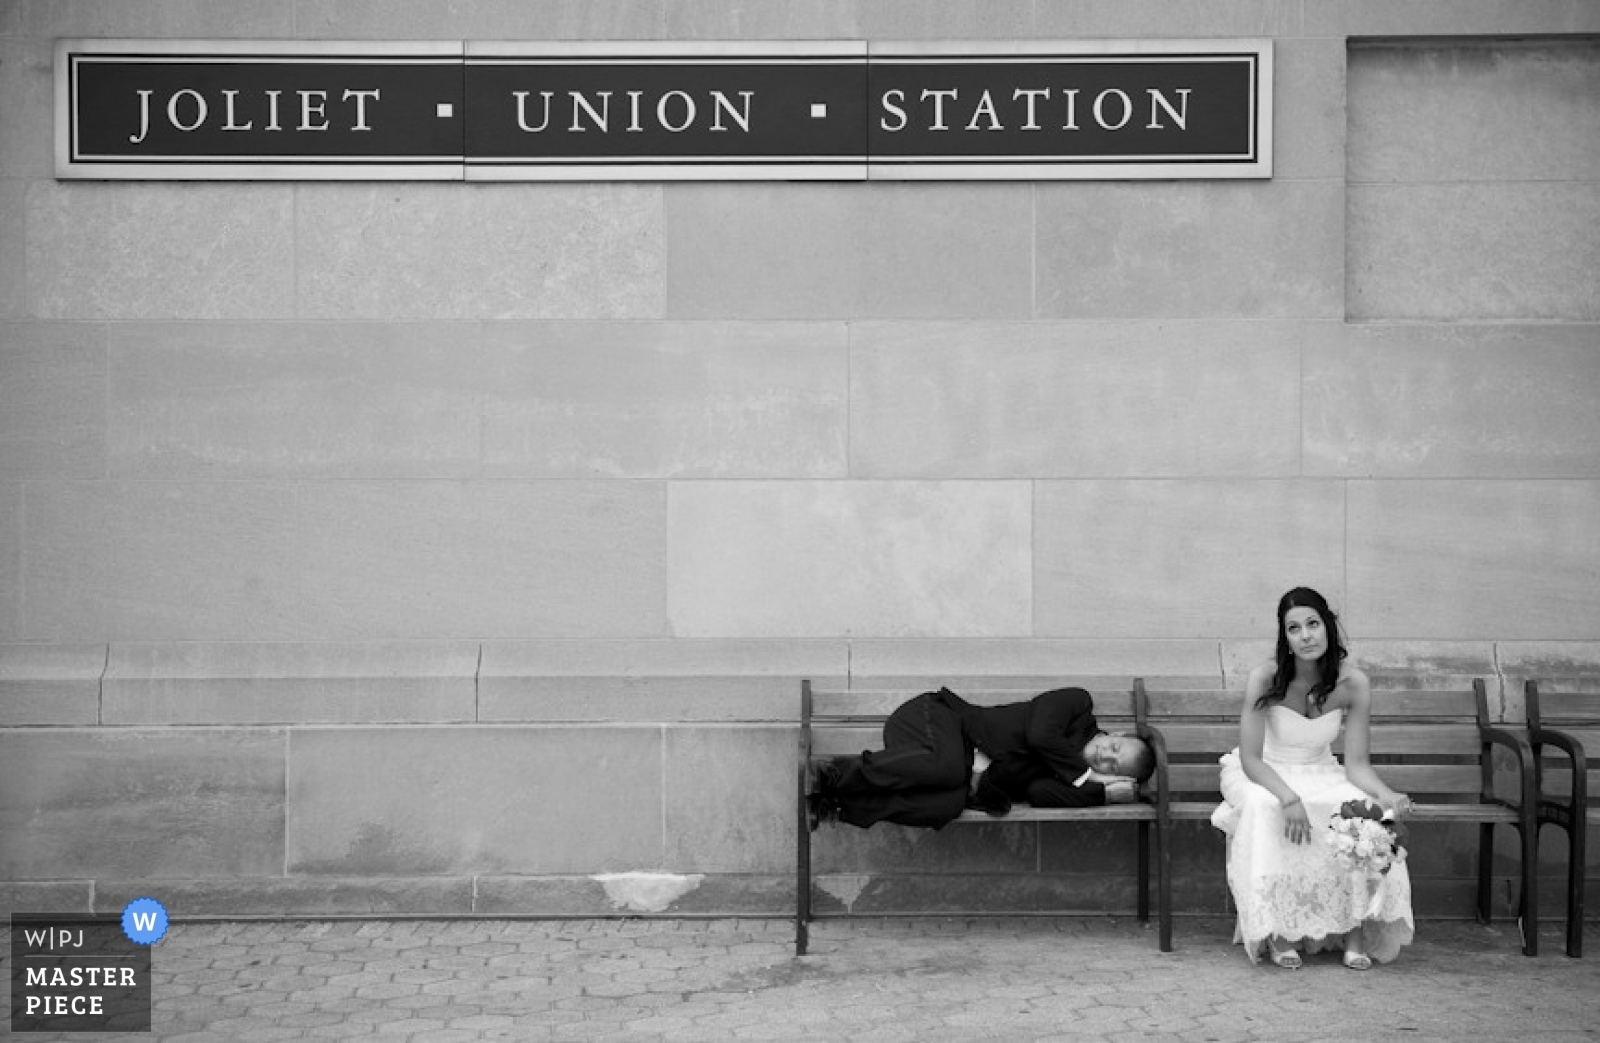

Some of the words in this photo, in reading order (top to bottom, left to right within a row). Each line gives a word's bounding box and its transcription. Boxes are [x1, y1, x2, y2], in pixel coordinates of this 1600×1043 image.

[129, 88, 381, 143] JOLIET
[512, 90, 755, 133] UNION
[880, 88, 1192, 131] STATION
